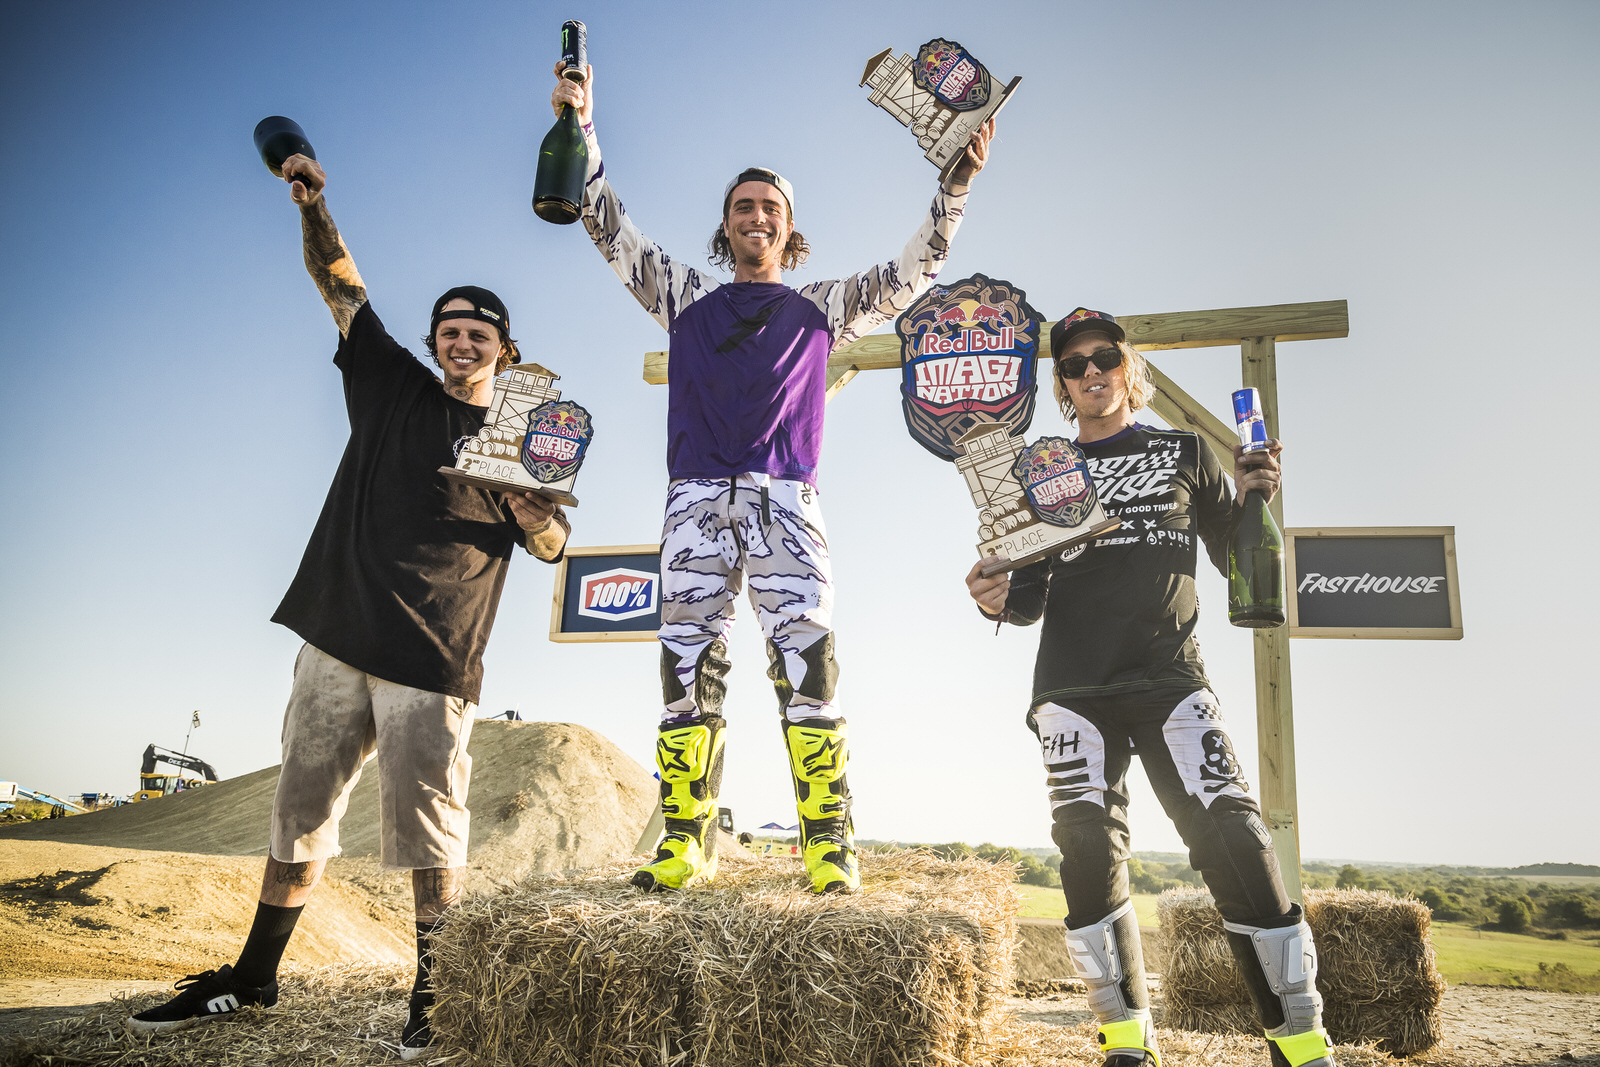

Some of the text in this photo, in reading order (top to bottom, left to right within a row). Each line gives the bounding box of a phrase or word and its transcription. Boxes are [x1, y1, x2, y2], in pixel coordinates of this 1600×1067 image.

[929, 51, 960, 86] Red Bull
[943, 118, 973, 151] PLACE
[923, 326, 1015, 356] Red Bull
[915, 355, 1023, 387] IMAGI
[916, 380, 1019, 405] NATION
[538, 422, 581, 439] Red Bull
[477, 461, 518, 480] PLACE
[1029, 457, 1076, 484] Red Bull
[1125, 505, 1152, 514] GOOD
[1153, 502, 1178, 512] TIMES
[1004, 528, 1047, 555] PLACE
[1063, 542, 1085, 558] BELL
[1157, 530, 1190, 546] PURE
[589, 580, 648, 608] 100%
[1297, 572, 1446, 595] FASTHOUSE
